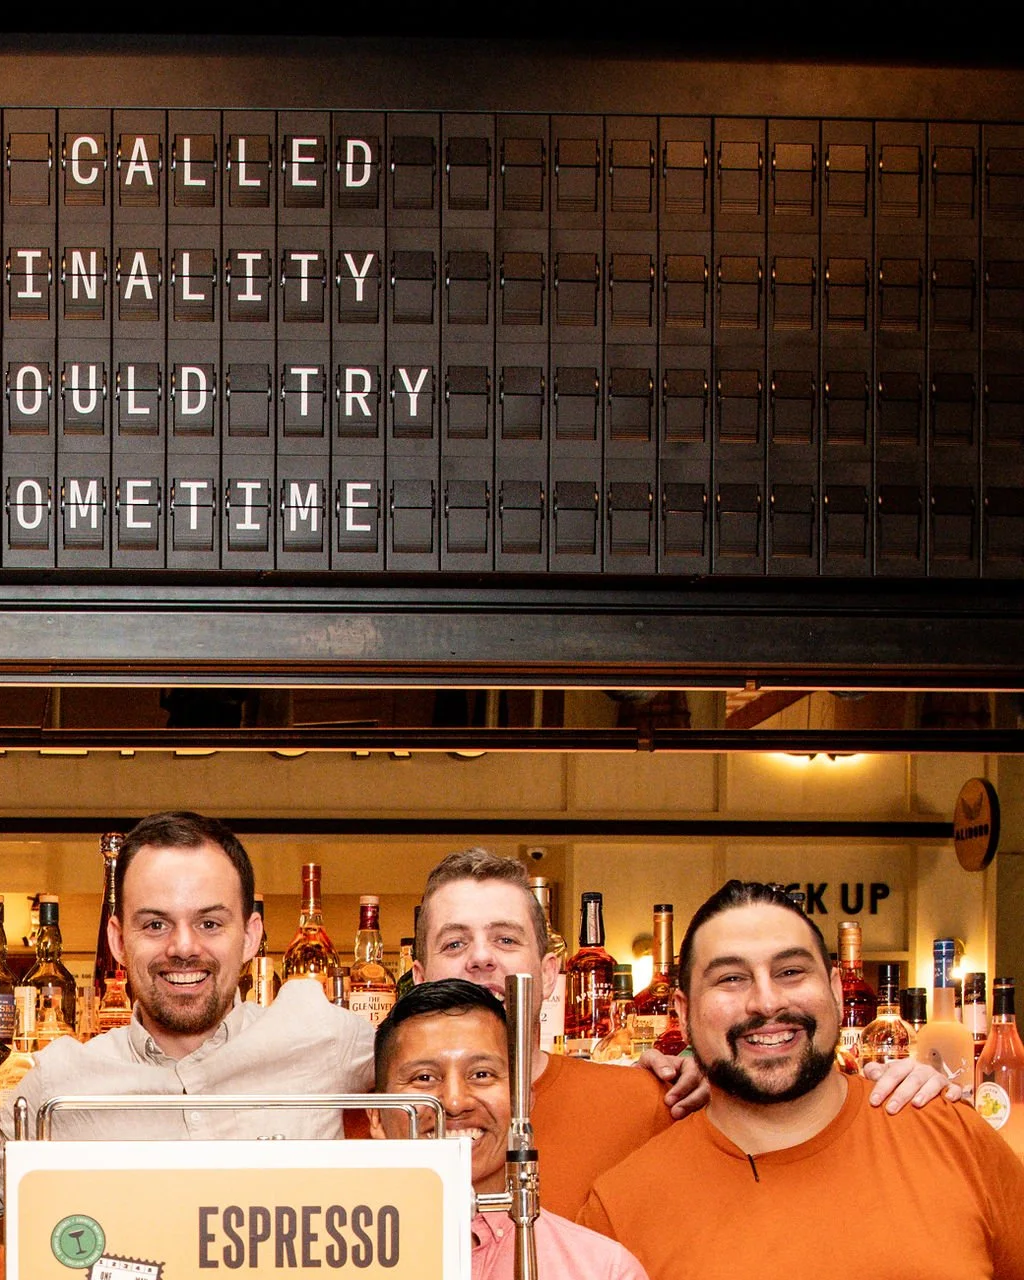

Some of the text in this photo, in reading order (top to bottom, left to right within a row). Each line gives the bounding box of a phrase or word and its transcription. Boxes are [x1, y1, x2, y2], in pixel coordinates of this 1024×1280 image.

[71, 136, 372, 187] CALLED
[290, 368, 429, 416] TRY
[840, 883, 890, 915] UP
[352, 1002, 393, 1012] GLENLIVET
[369, 1012, 379, 1021] 15
[198, 1204, 400, 1269] ESPRESSO
